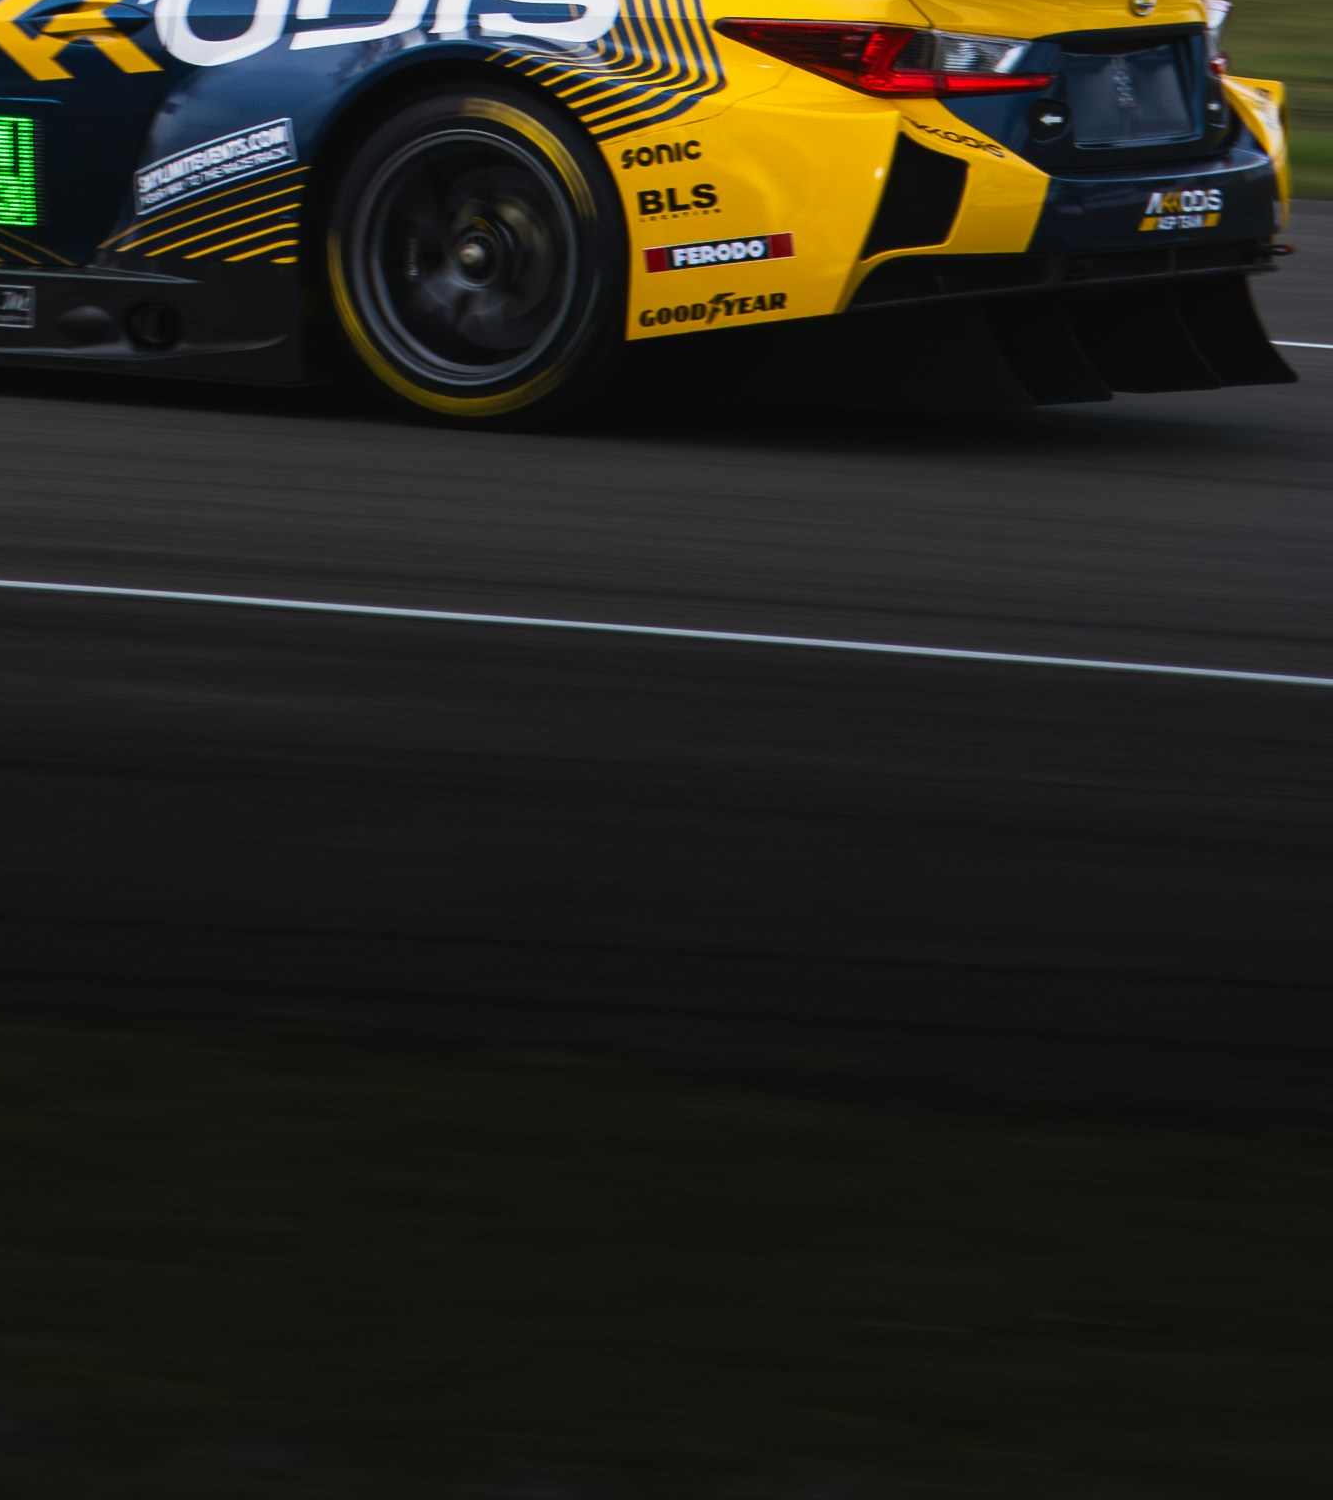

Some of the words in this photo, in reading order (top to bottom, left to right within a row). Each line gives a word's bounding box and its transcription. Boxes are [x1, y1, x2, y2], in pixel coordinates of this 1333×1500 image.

[637, 183, 717, 216] BLS
[672, 240, 765, 267] FERODO
[639, 292, 788, 328] GOODYEAR
